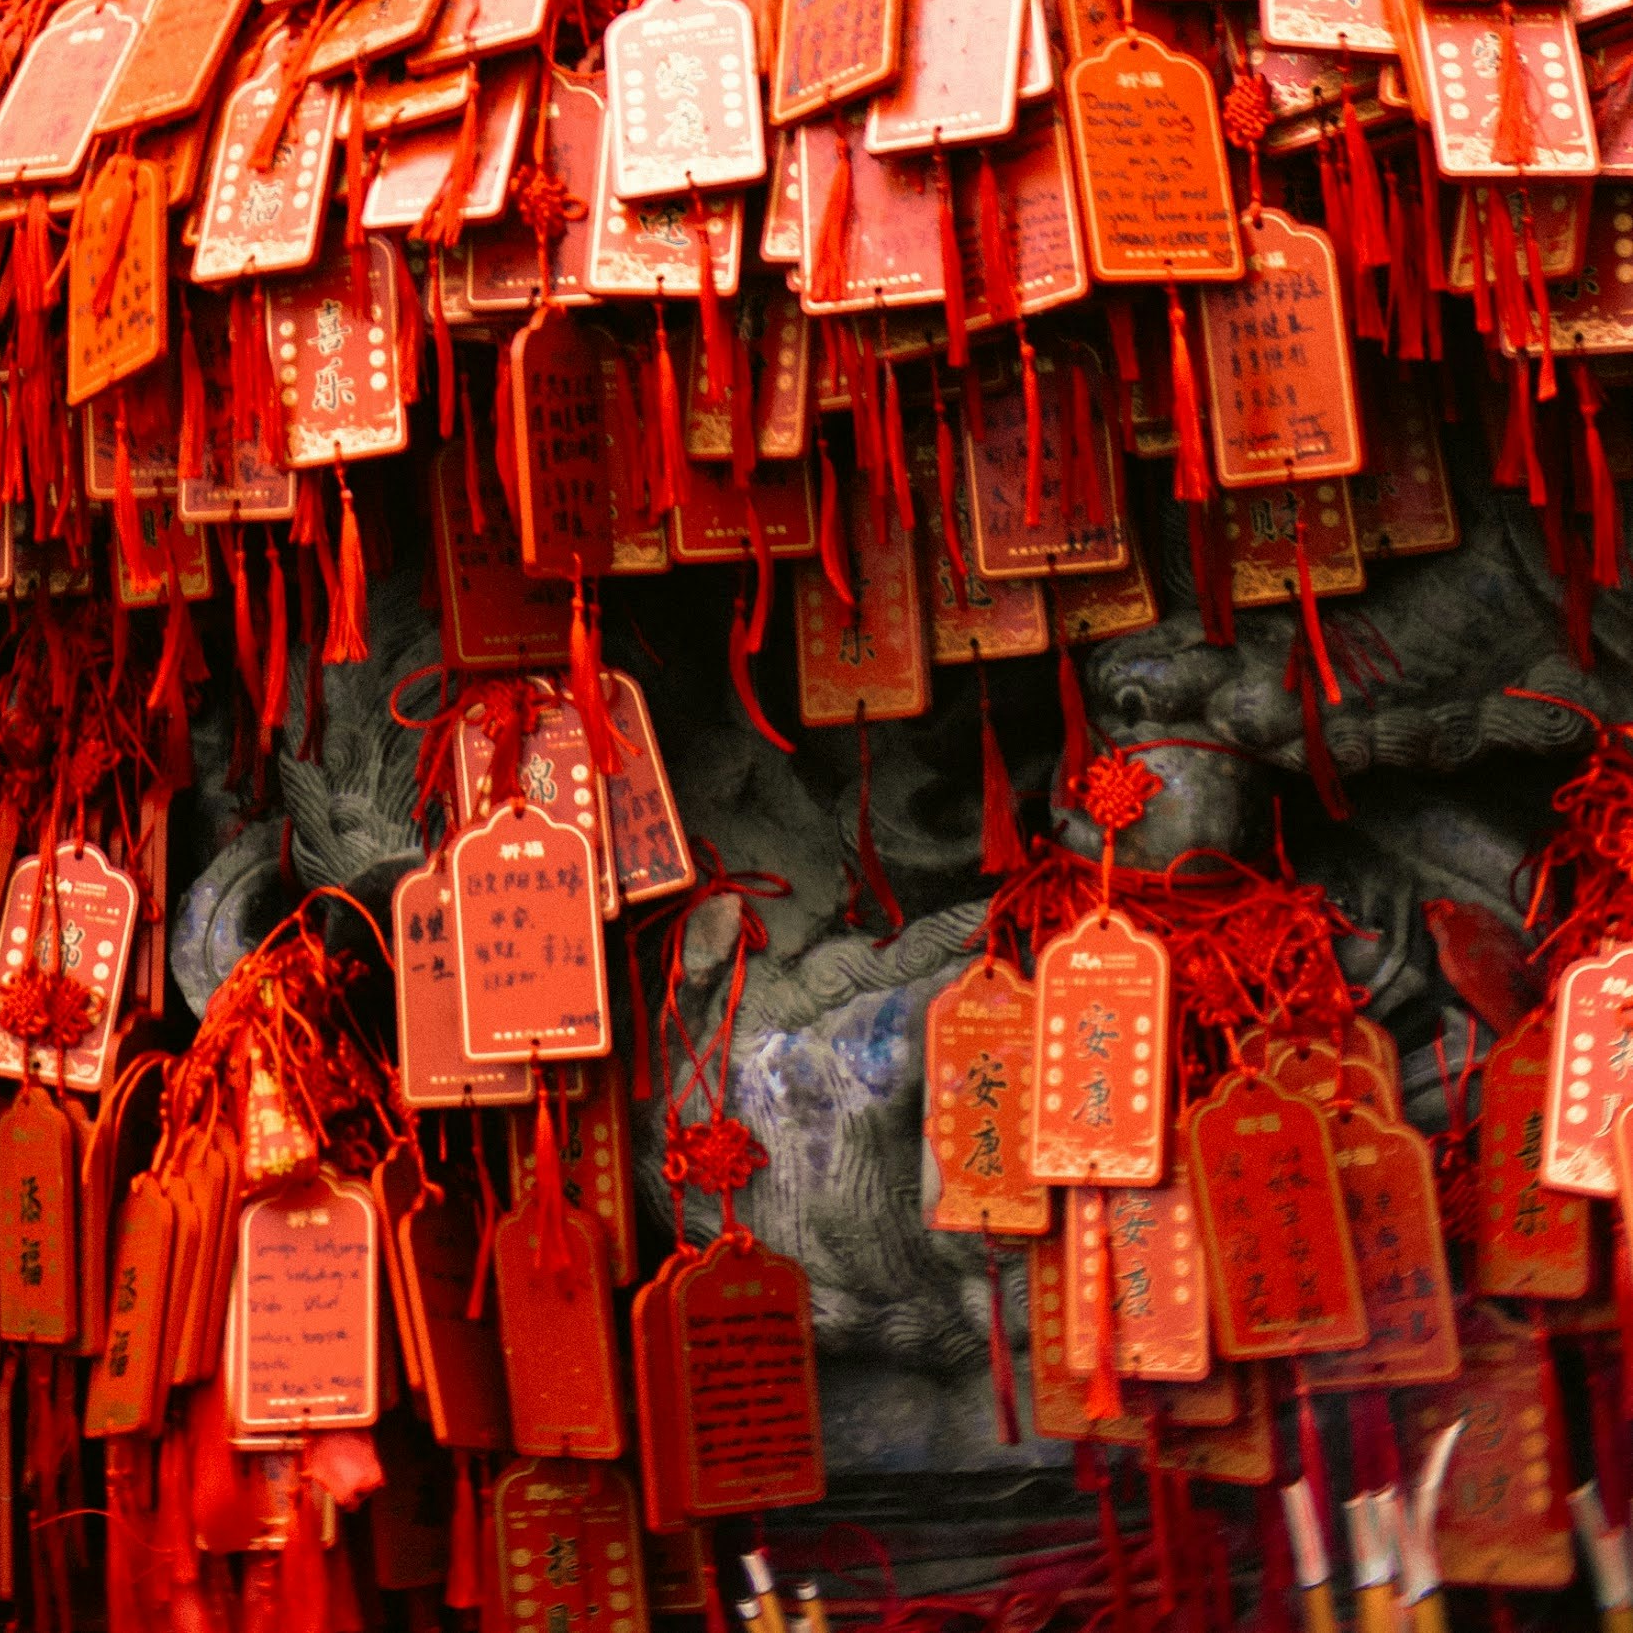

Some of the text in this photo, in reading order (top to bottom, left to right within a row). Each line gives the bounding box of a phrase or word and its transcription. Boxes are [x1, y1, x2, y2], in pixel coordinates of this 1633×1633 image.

[307, 297, 355, 413] 喜乐
[964, 1052, 1008, 1178] 安康
[1073, 1004, 1121, 1129] 安康
[1114, 1189, 1158, 1318] 安康
